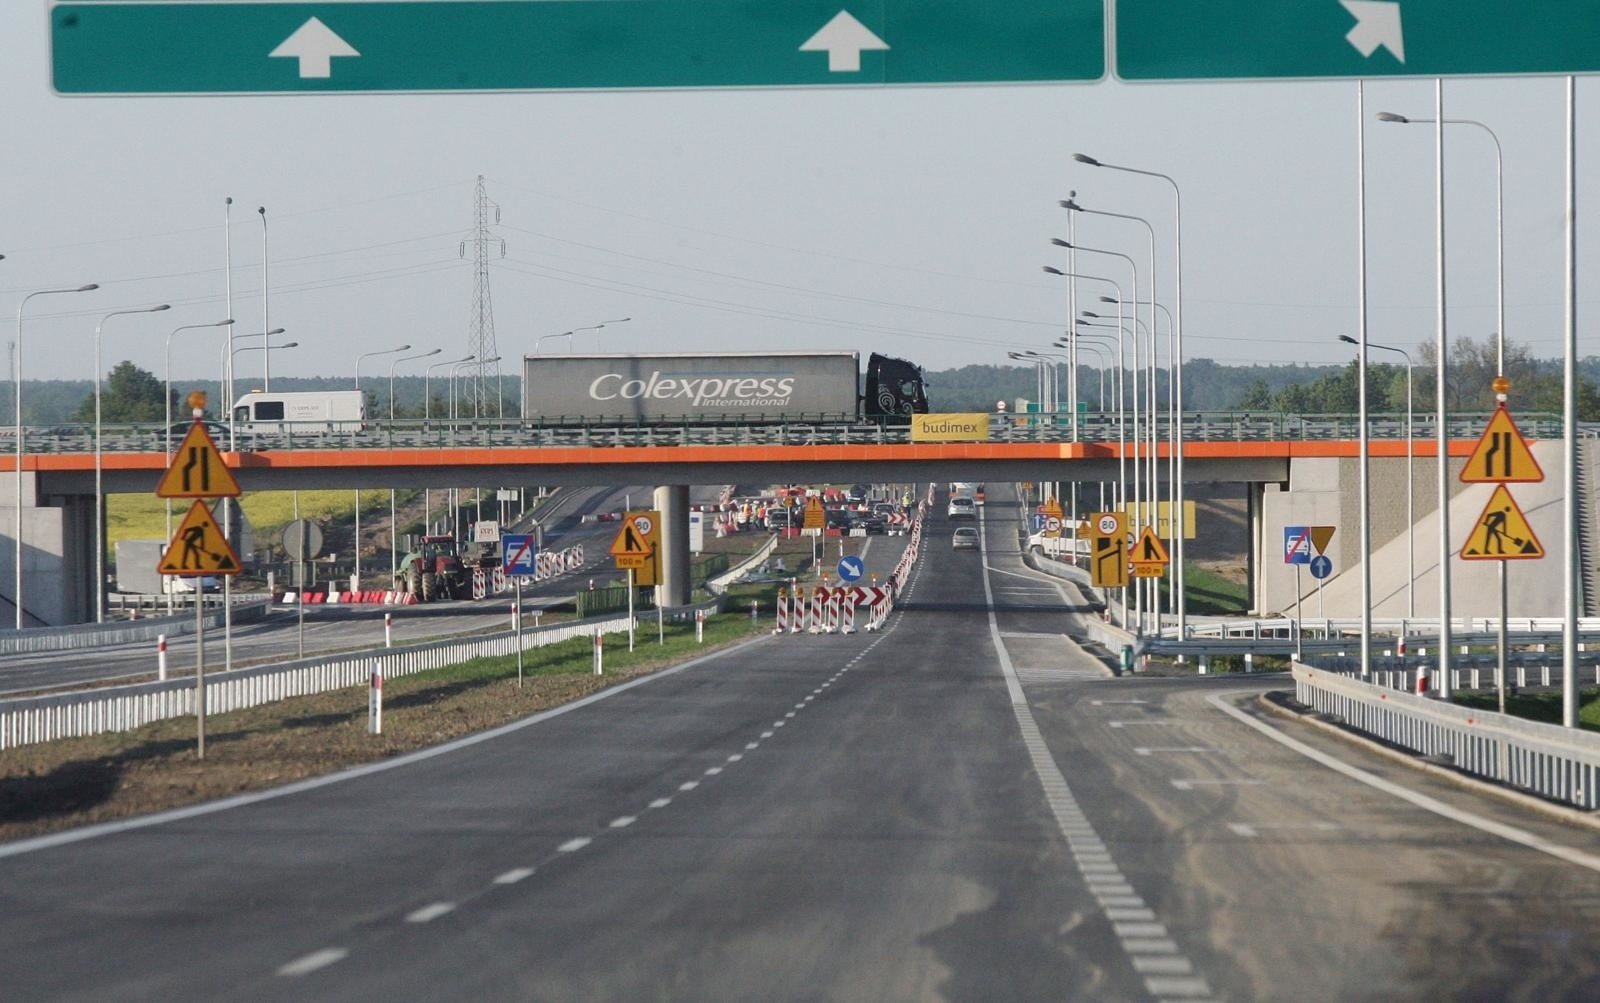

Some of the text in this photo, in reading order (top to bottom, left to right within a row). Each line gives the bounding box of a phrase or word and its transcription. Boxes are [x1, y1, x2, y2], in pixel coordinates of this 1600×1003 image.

[589, 371, 795, 406] Colexpress
[702, 397, 791, 407] International
[922, 421, 978, 433] budimex
[1102, 520, 1115, 530] 80
[618, 558, 633, 566] 100
